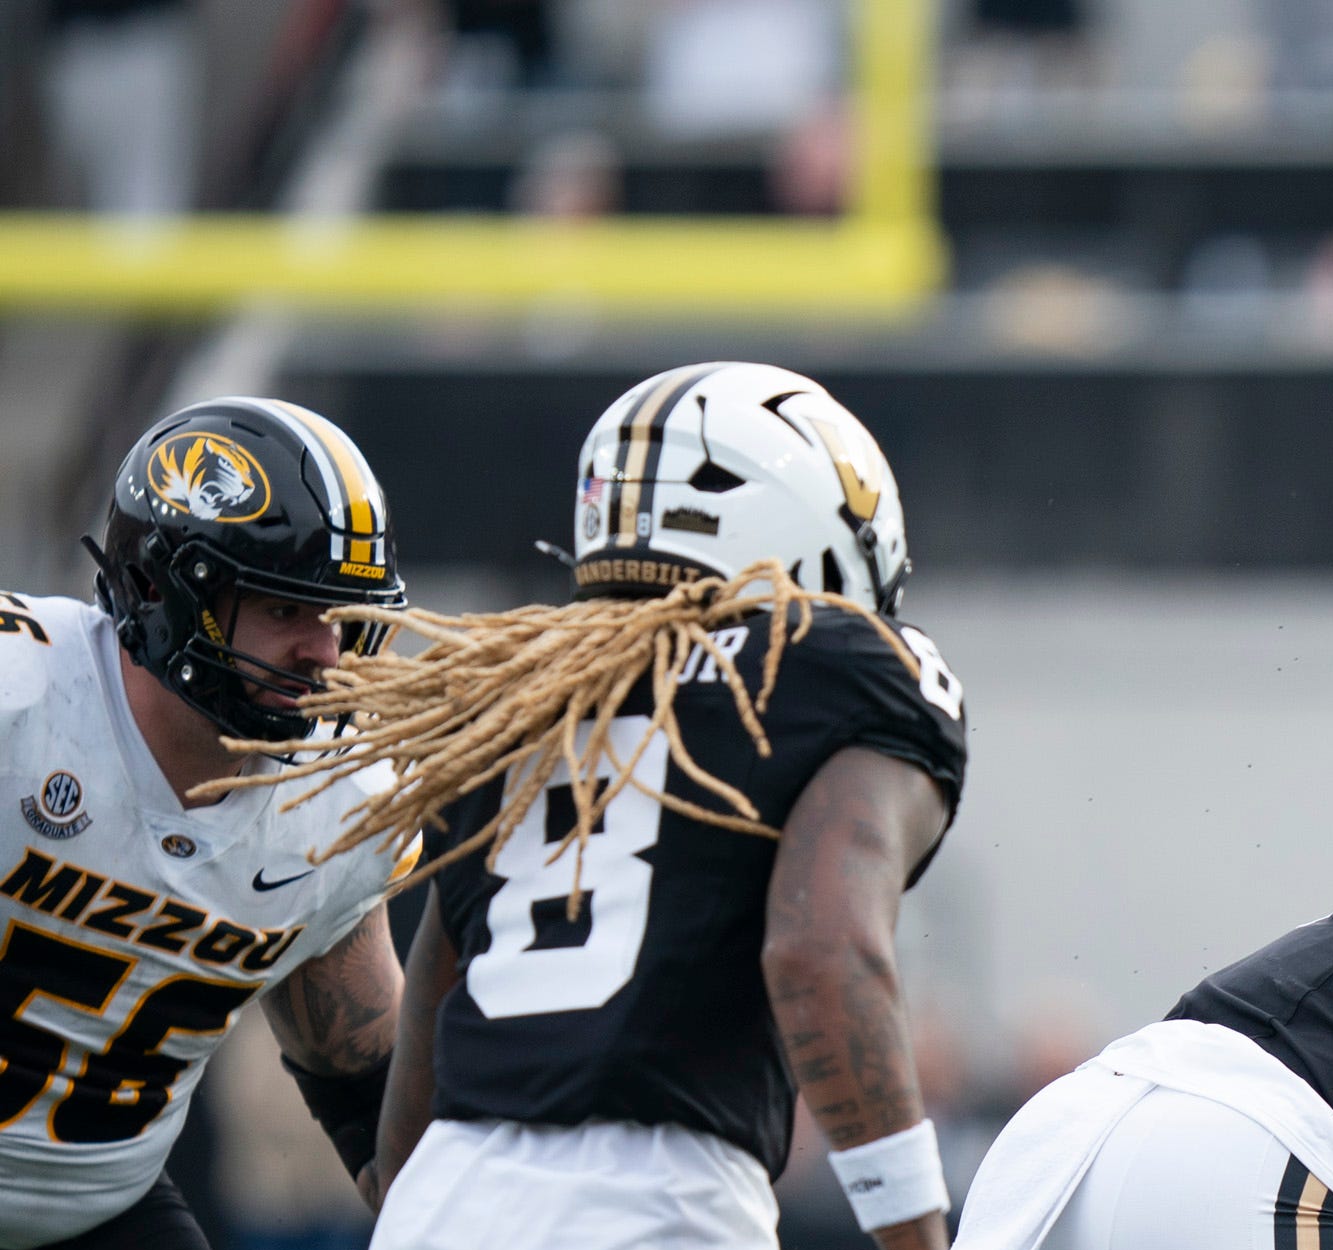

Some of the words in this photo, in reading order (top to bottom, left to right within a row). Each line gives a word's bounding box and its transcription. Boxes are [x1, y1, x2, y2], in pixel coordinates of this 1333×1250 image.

[339, 561, 386, 579] MIZZOU
[637, 512, 651, 537] 8
[899, 625, 963, 721] 8
[44, 772, 81, 815] SEC
[0, 846, 304, 972] MIZZOU
[466, 714, 670, 1020] 8
[0, 918, 266, 1145] 56
